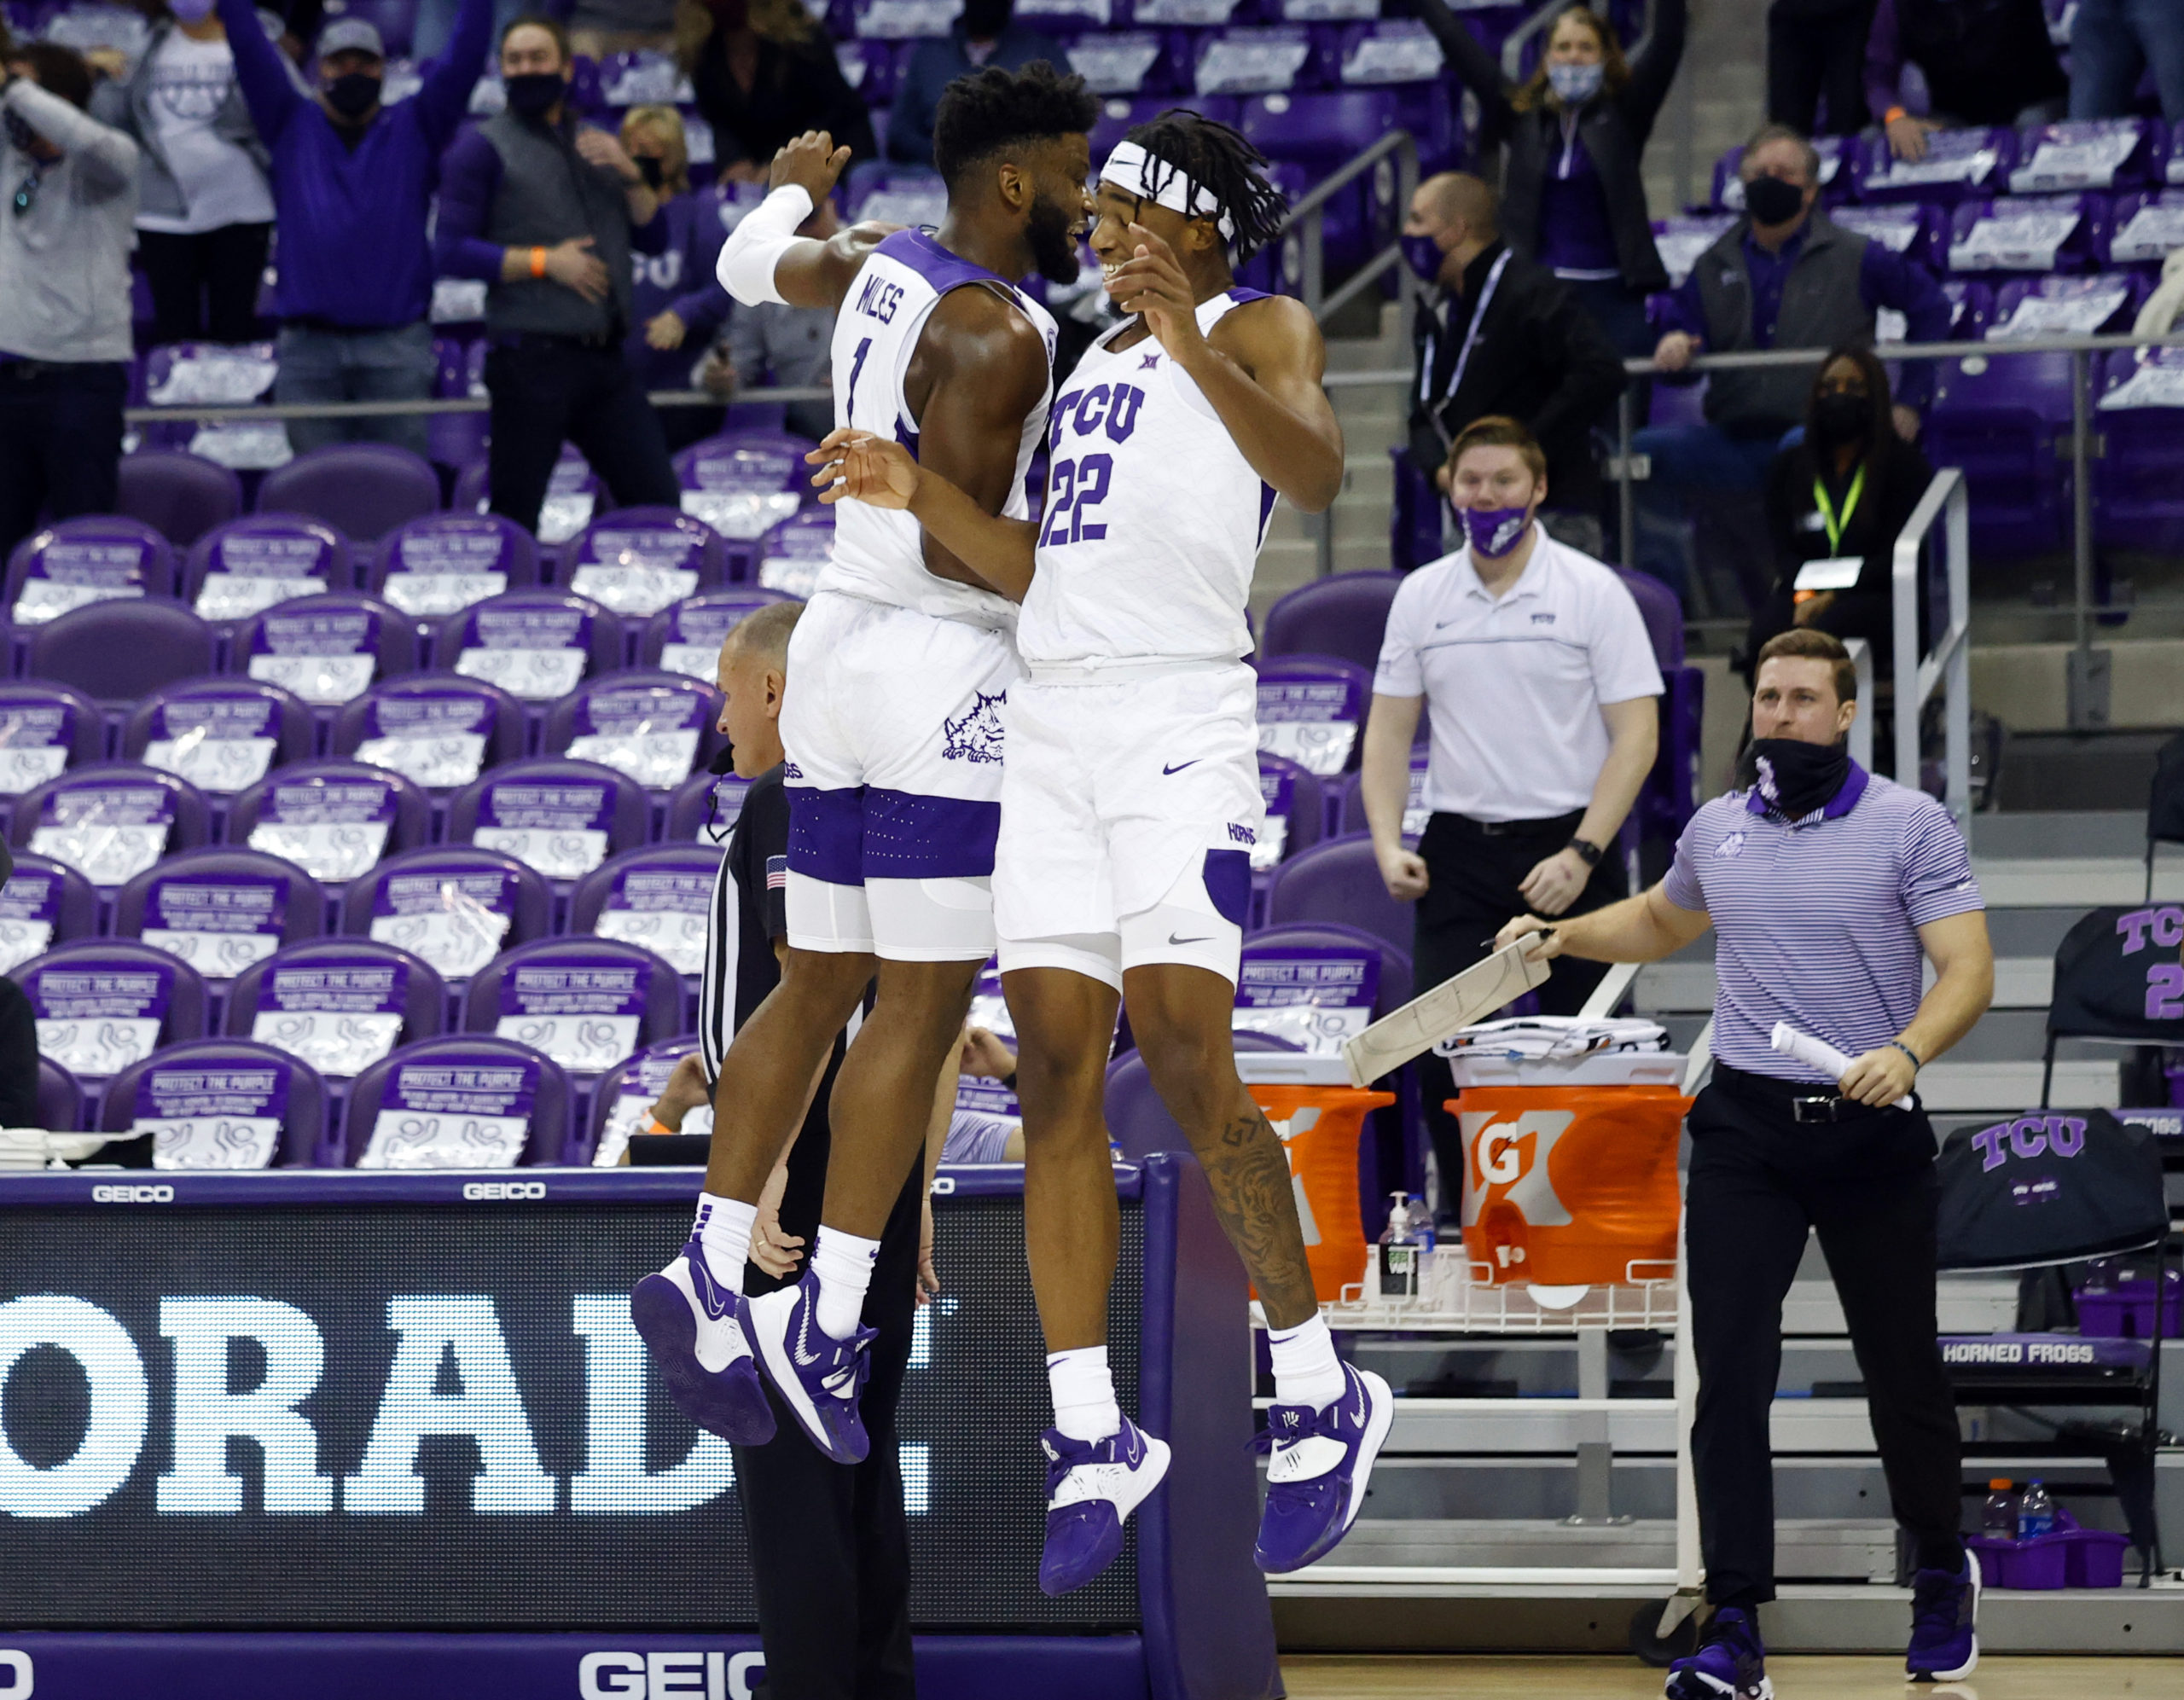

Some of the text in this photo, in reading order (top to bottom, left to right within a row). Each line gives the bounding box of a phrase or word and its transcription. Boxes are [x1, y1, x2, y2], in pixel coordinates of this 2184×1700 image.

[856, 274, 904, 325] MILES
[846, 337, 873, 428] 1
[1050, 382, 1146, 455] TCU
[1037, 453, 1113, 548] 22
[1972, 1117, 2088, 1173] TCU
[92, 1185, 175, 1203] GEICO
[462, 1181, 547, 1200] GEICO
[1943, 1343, 2094, 1364] HORNED FROGS
